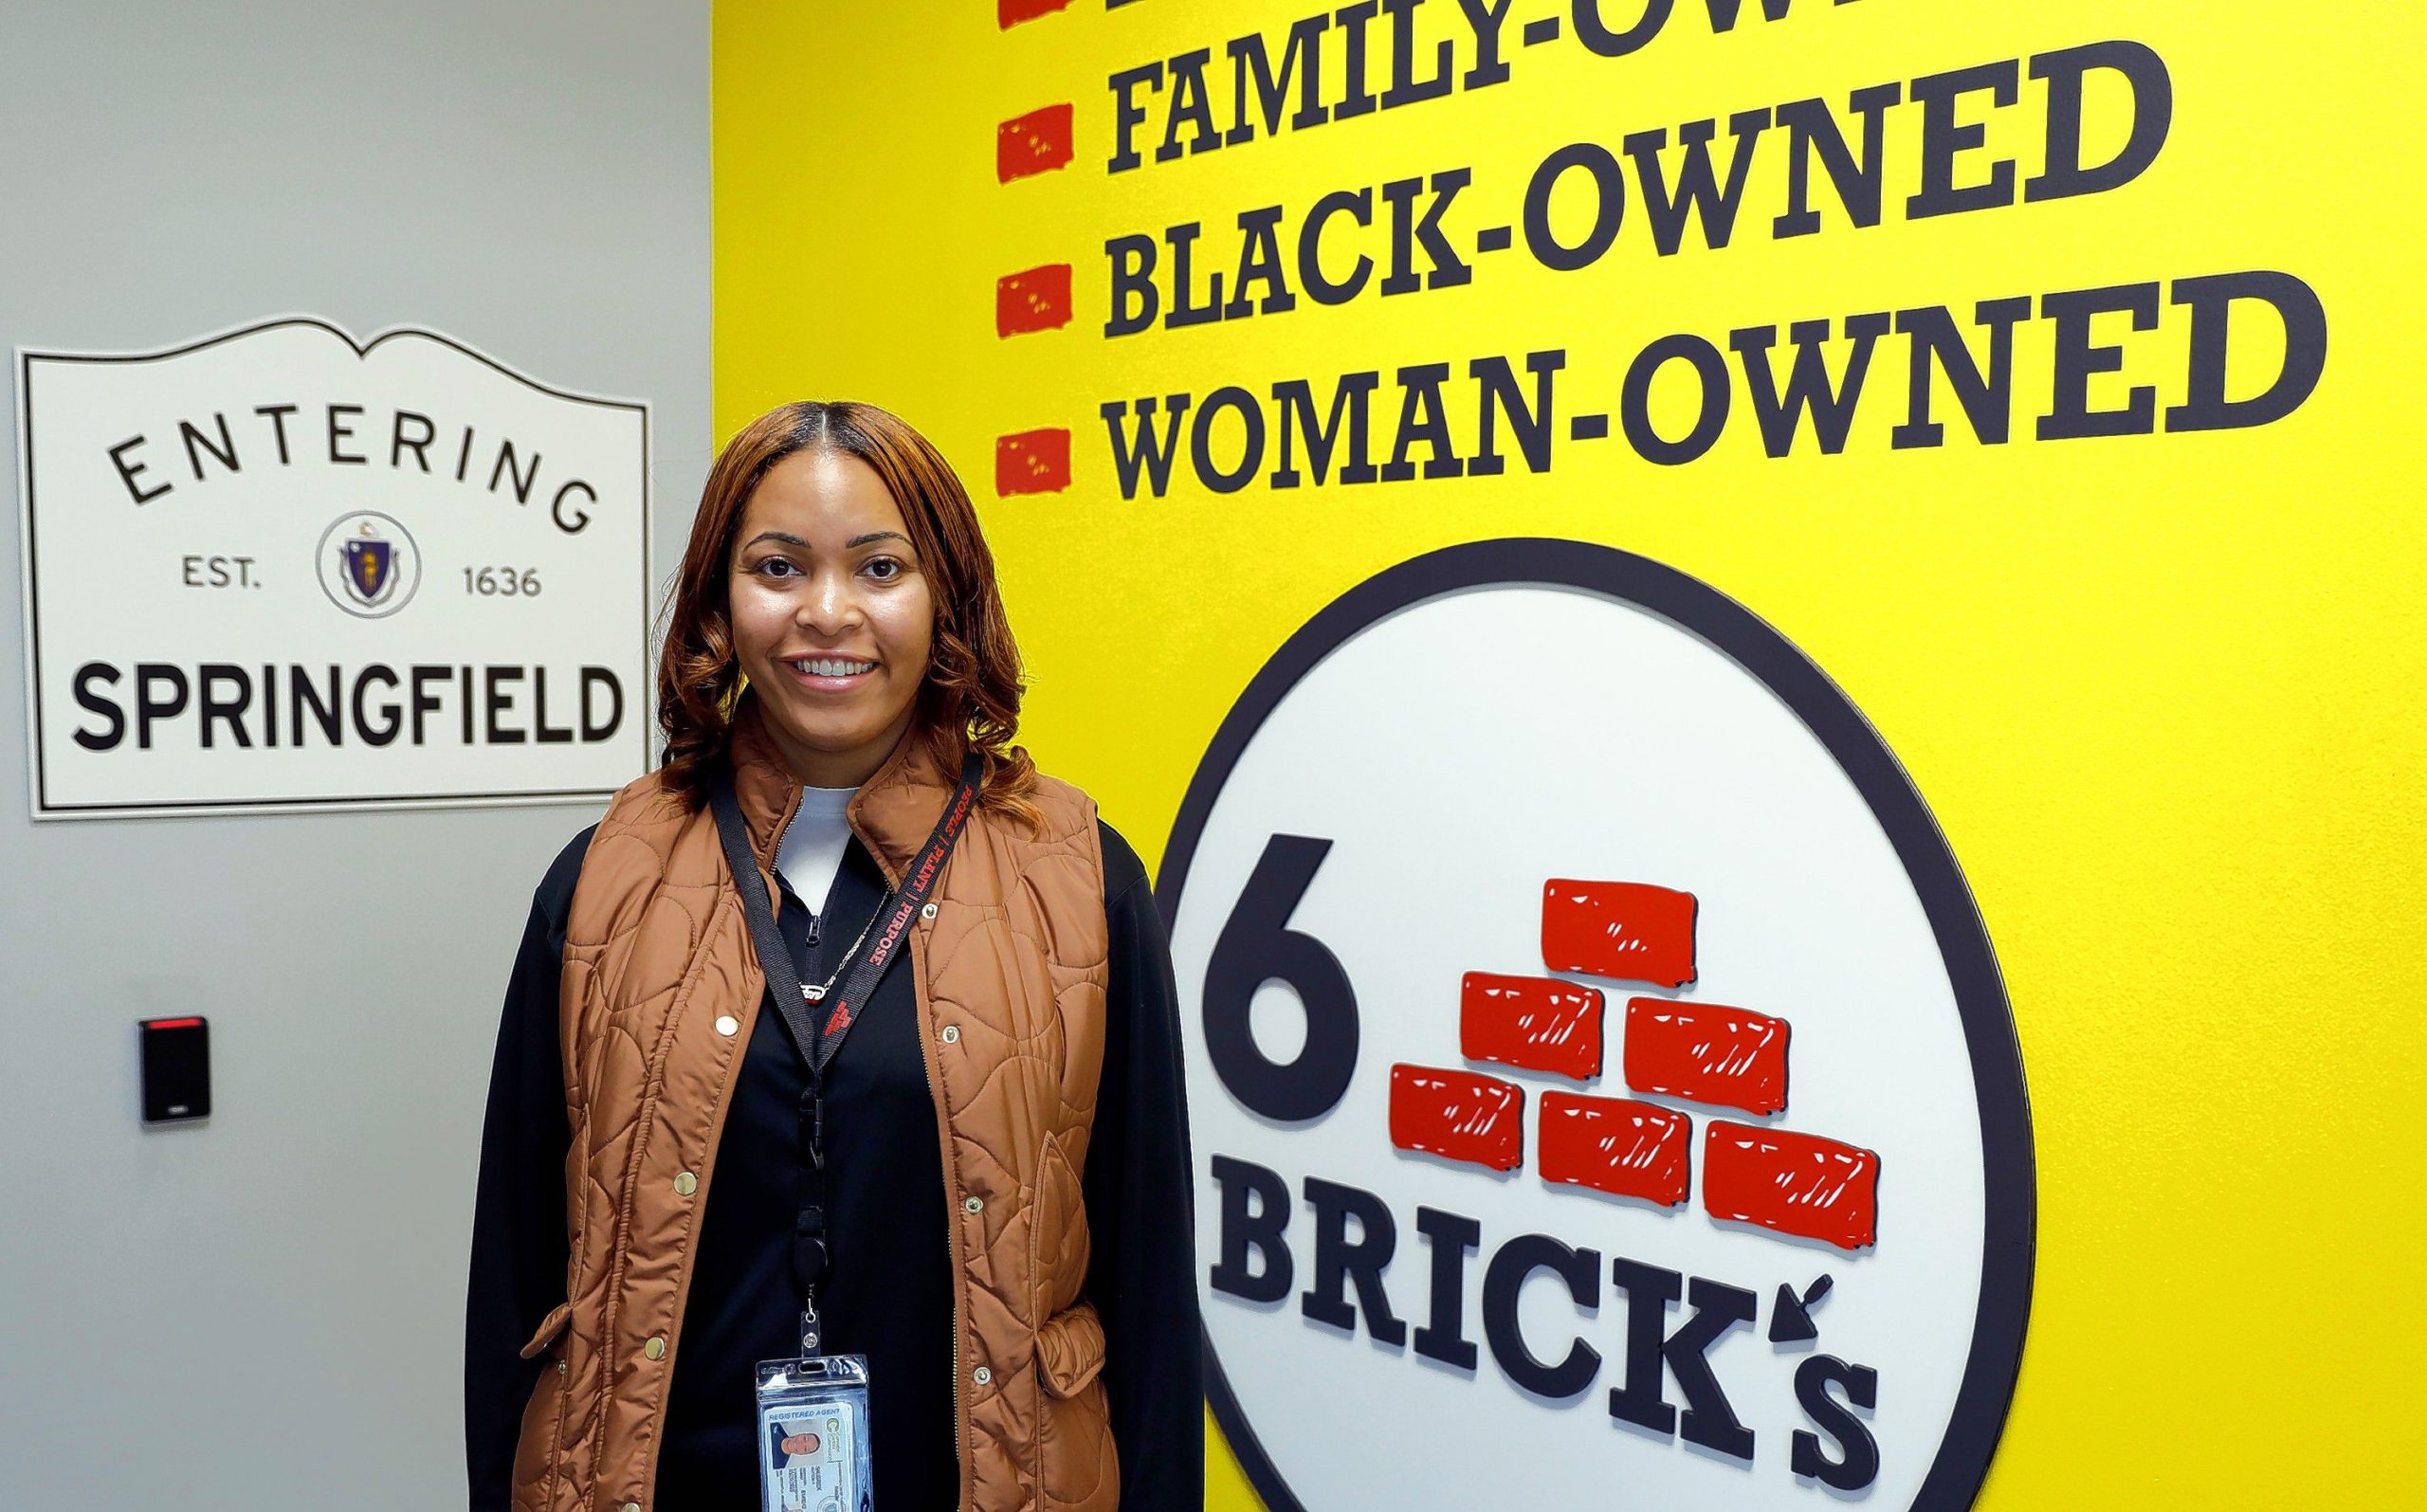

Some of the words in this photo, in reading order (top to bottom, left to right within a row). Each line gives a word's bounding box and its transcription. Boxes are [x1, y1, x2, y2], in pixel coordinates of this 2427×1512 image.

[1104, 40, 2173, 339] BLACK-OWNED
[1100, 270, 2327, 501] WOMAN-OWNED
[107, 404, 597, 534] ENTERING
[181, 556, 261, 589] EST.
[463, 566, 542, 597] 1636
[72, 662, 624, 752] SPRINGFIELD
[945, 785, 973, 837] PEOPLE
[912, 844, 945, 893] PLANT
[869, 901, 914, 966] PURPOSE
[1201, 833, 1360, 1123] 6
[769, 1410, 814, 1421] REGISTERED
[815, 1408, 840, 1417] AGENT
